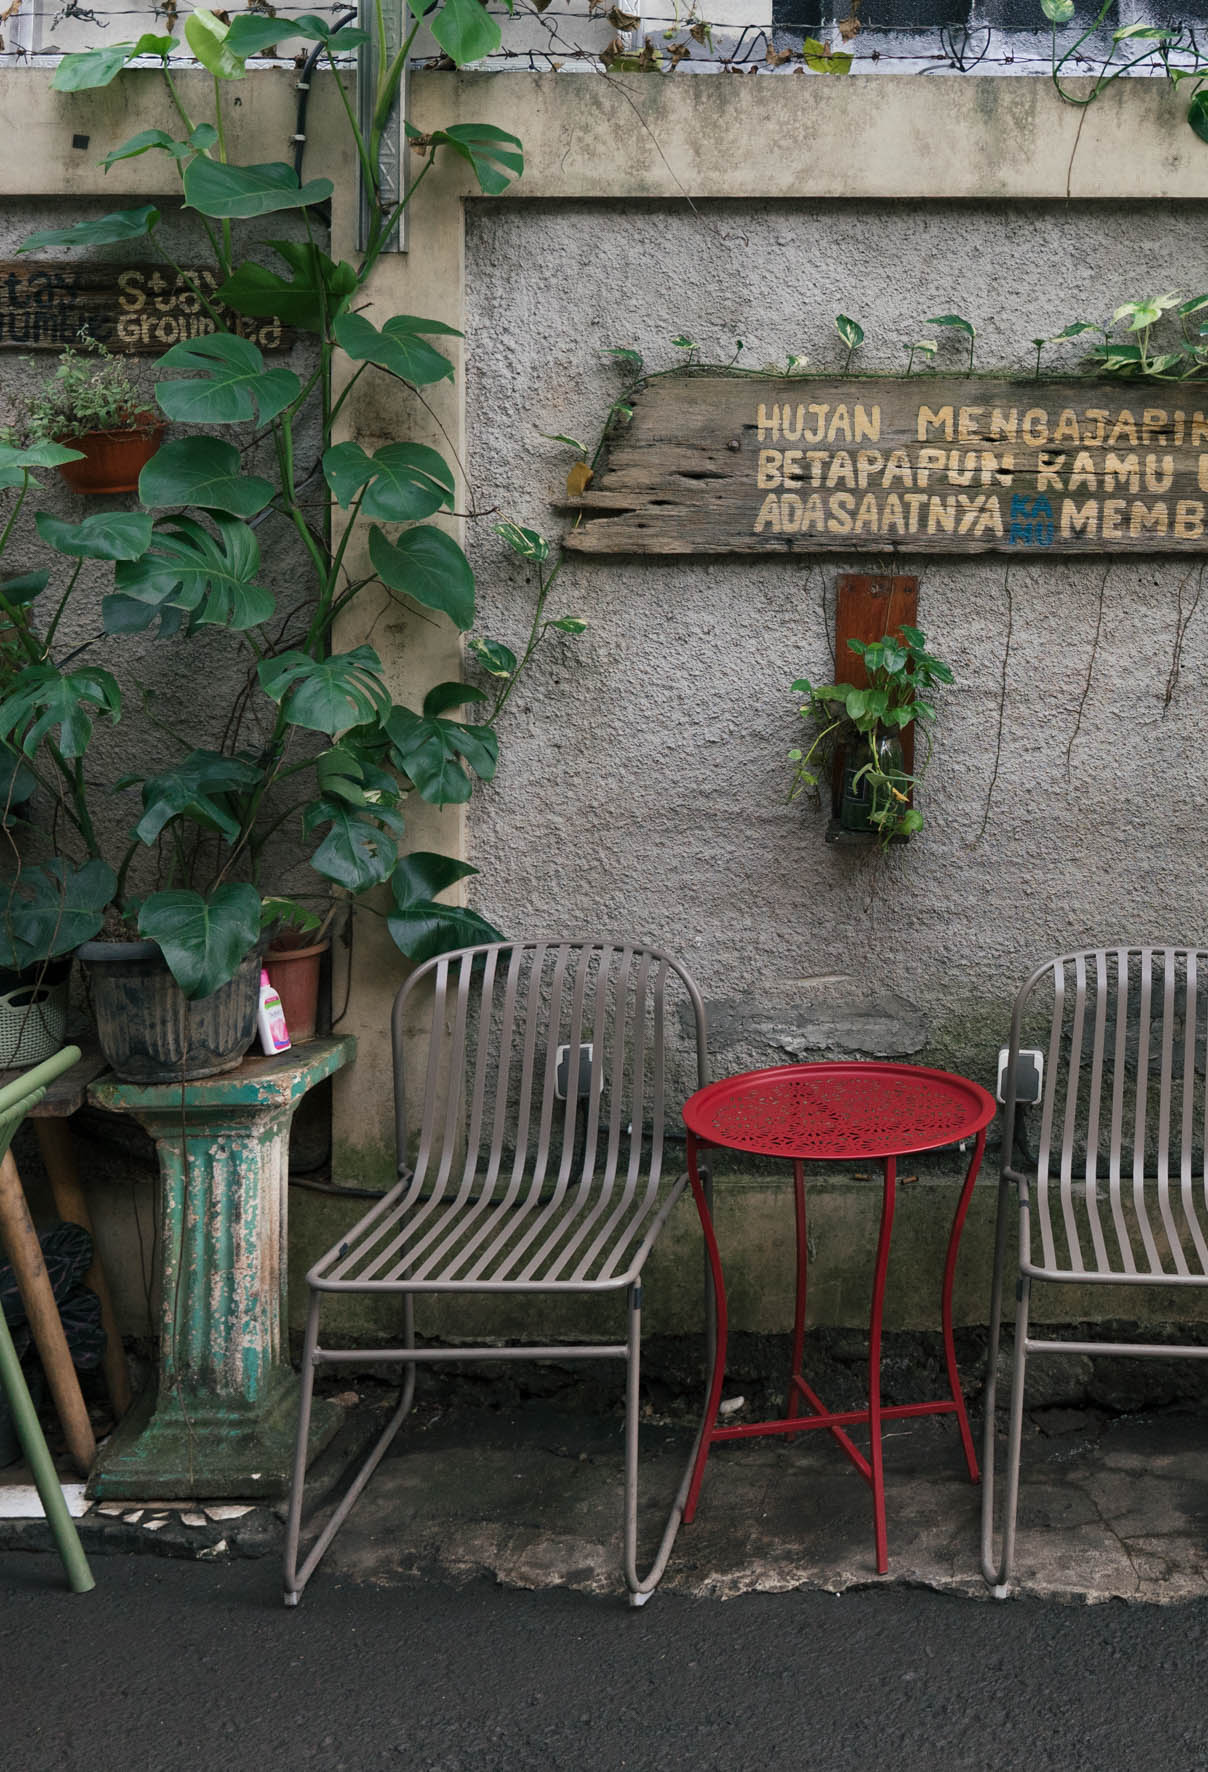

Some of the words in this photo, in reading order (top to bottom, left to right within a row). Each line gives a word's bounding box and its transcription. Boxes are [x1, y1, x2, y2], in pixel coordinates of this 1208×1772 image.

[116, 312, 282, 348] Grouned
[757, 403, 880, 443] HUJAN
[757, 448, 1014, 490] BETAPAPUN
[1037, 451, 1174, 493] KAMU
